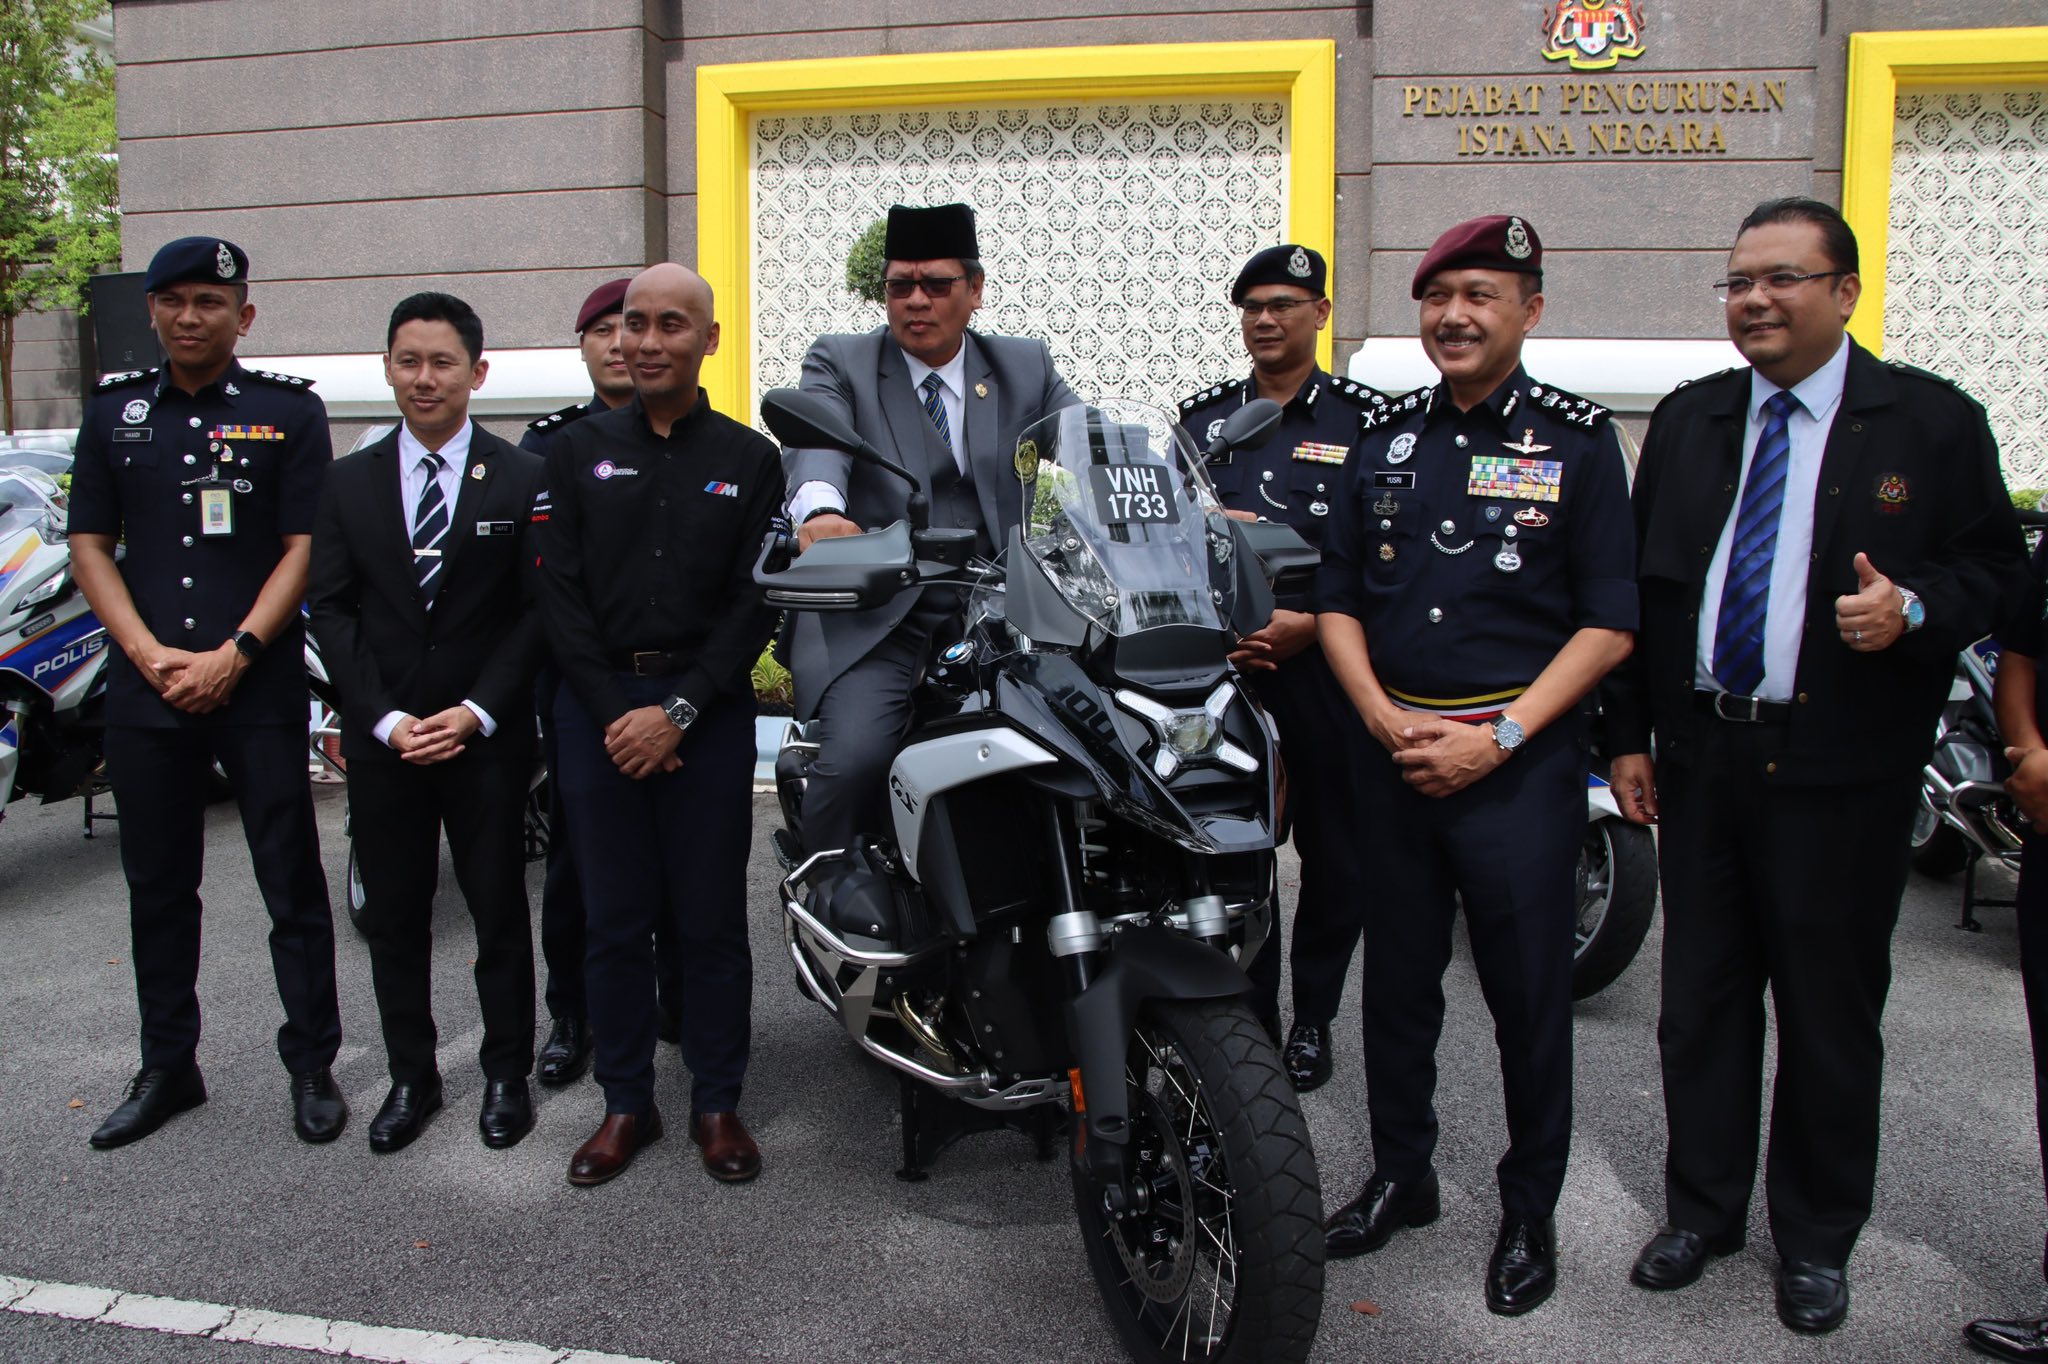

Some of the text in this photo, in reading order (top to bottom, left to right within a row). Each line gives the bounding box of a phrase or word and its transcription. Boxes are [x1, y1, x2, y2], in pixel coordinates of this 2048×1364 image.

[1403, 79, 1786, 117] PEJABAT PENGURUSAN
[1458, 121, 1727, 156] ISTANA NEGARA
[1104, 467, 1159, 492] VNH
[1386, 476, 1402, 484] YUSRI
[1108, 493, 1168, 519] 1733
[33, 636, 104, 680] POLIS
